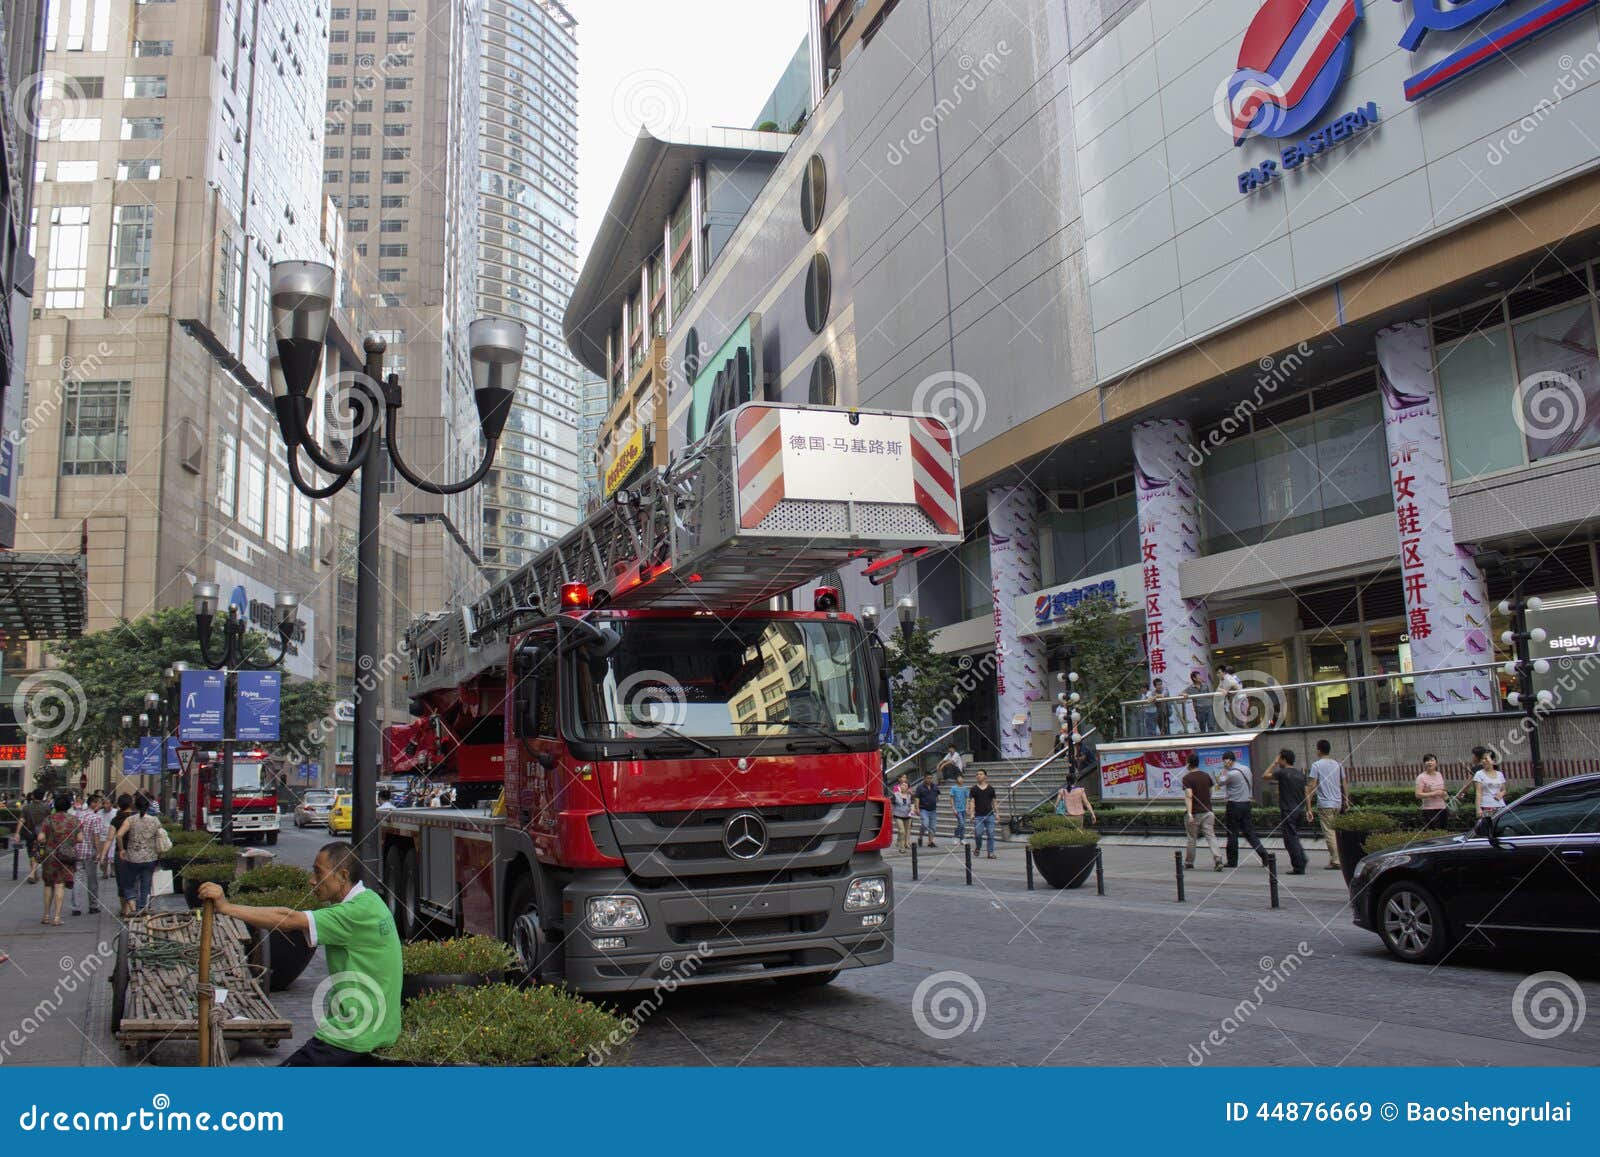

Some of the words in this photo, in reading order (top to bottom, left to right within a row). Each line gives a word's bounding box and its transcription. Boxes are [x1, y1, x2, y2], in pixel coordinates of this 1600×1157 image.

[1238, 160, 1281, 194] FAR
[1281, 101, 1378, 170] EASTERN
[1393, 469, 1433, 641] 女鞋区开幕
[1141, 538, 1167, 675] 女鞋区开幕
[1549, 634, 1597, 649] sisley
[1163, 770, 1172, 789] 5
